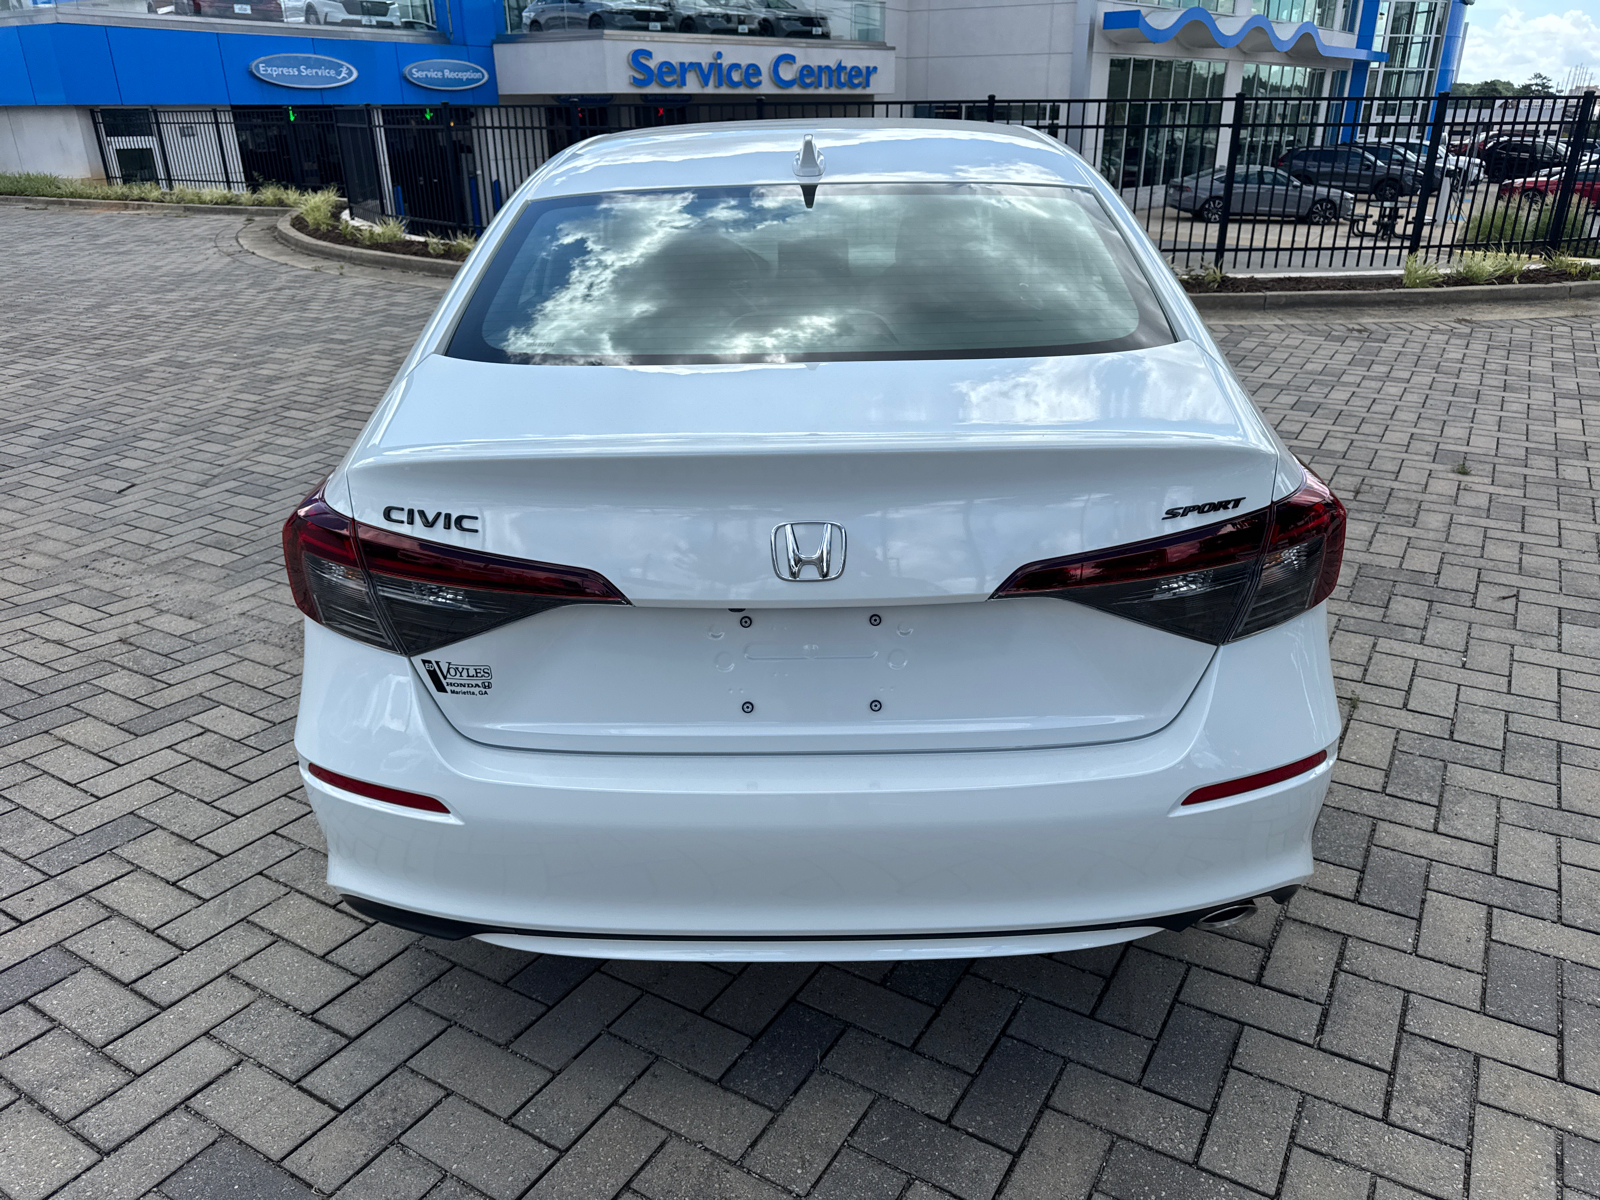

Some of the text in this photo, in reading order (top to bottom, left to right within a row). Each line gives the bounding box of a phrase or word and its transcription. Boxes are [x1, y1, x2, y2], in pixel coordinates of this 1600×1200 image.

[258, 63, 336, 78] Express Service
[411, 68, 483, 81] Service Reception
[628, 48, 878, 89] Service Center
[1161, 497, 1246, 520] SPORT
[382, 505, 479, 534] CIVIC
[435, 661, 491, 680] VOYLES
